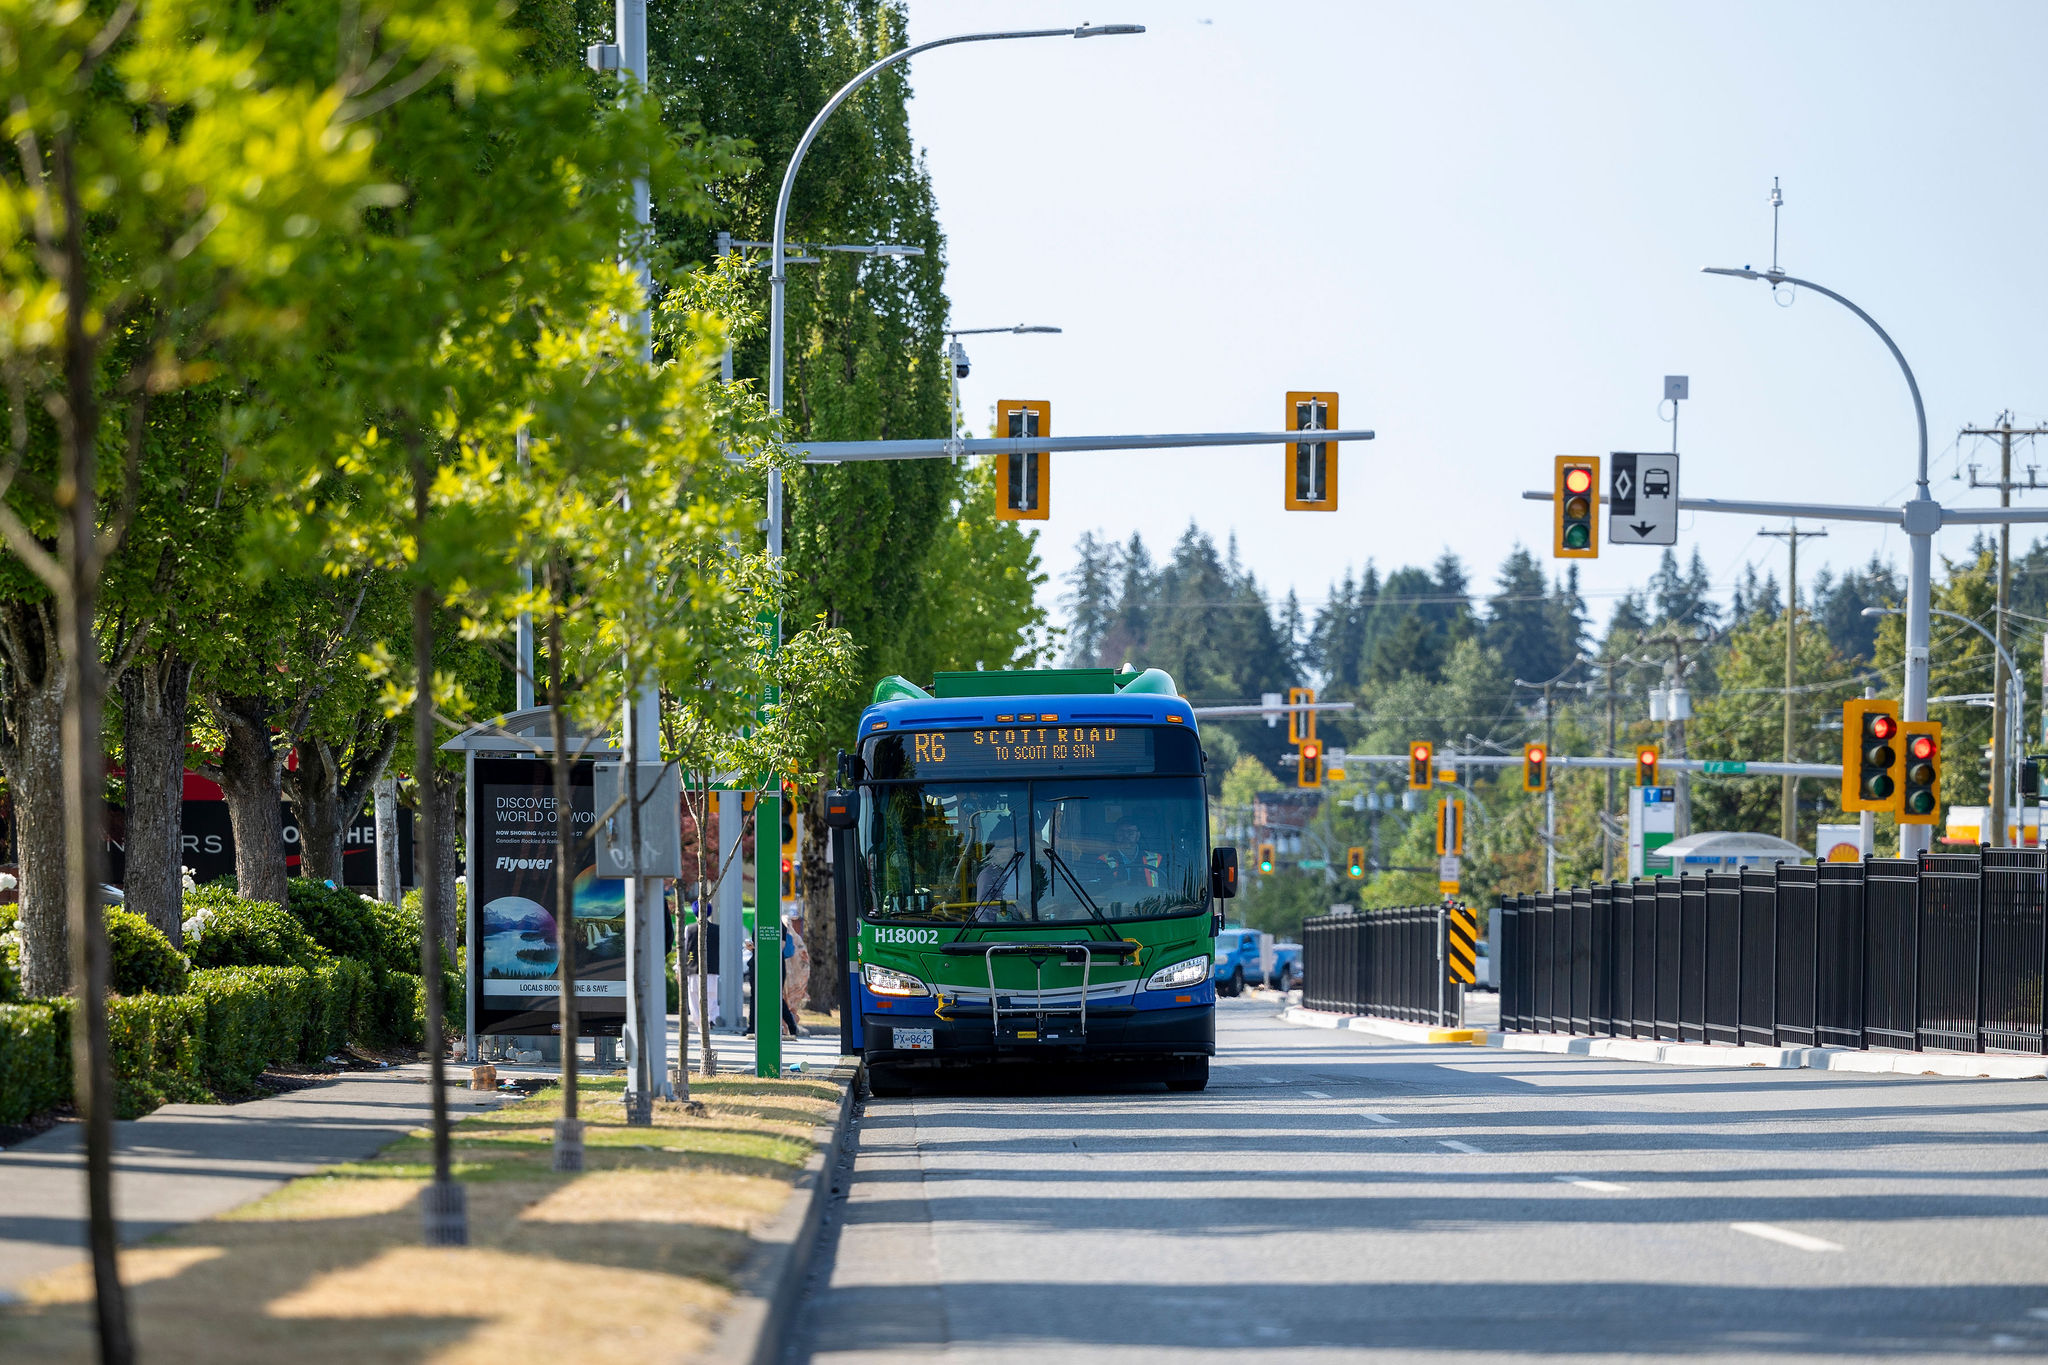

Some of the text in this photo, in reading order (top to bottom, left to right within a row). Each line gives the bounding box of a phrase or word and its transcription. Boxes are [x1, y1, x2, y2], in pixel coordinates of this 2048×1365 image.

[914, 727, 1116, 762] R6 SCOTT ROAD
[995, 743, 1095, 760] TO SCOTT RD STN
[496, 797, 560, 809] DISCOVER
[496, 811, 544, 822] WORLD
[569, 811, 597, 823] WON
[496, 856, 553, 873] Flyover
[875, 928, 939, 945] H18002
[519, 984, 543, 992] LOCALS
[544, 984, 562, 992] BOOK
[592, 985, 608, 993] SAVE
